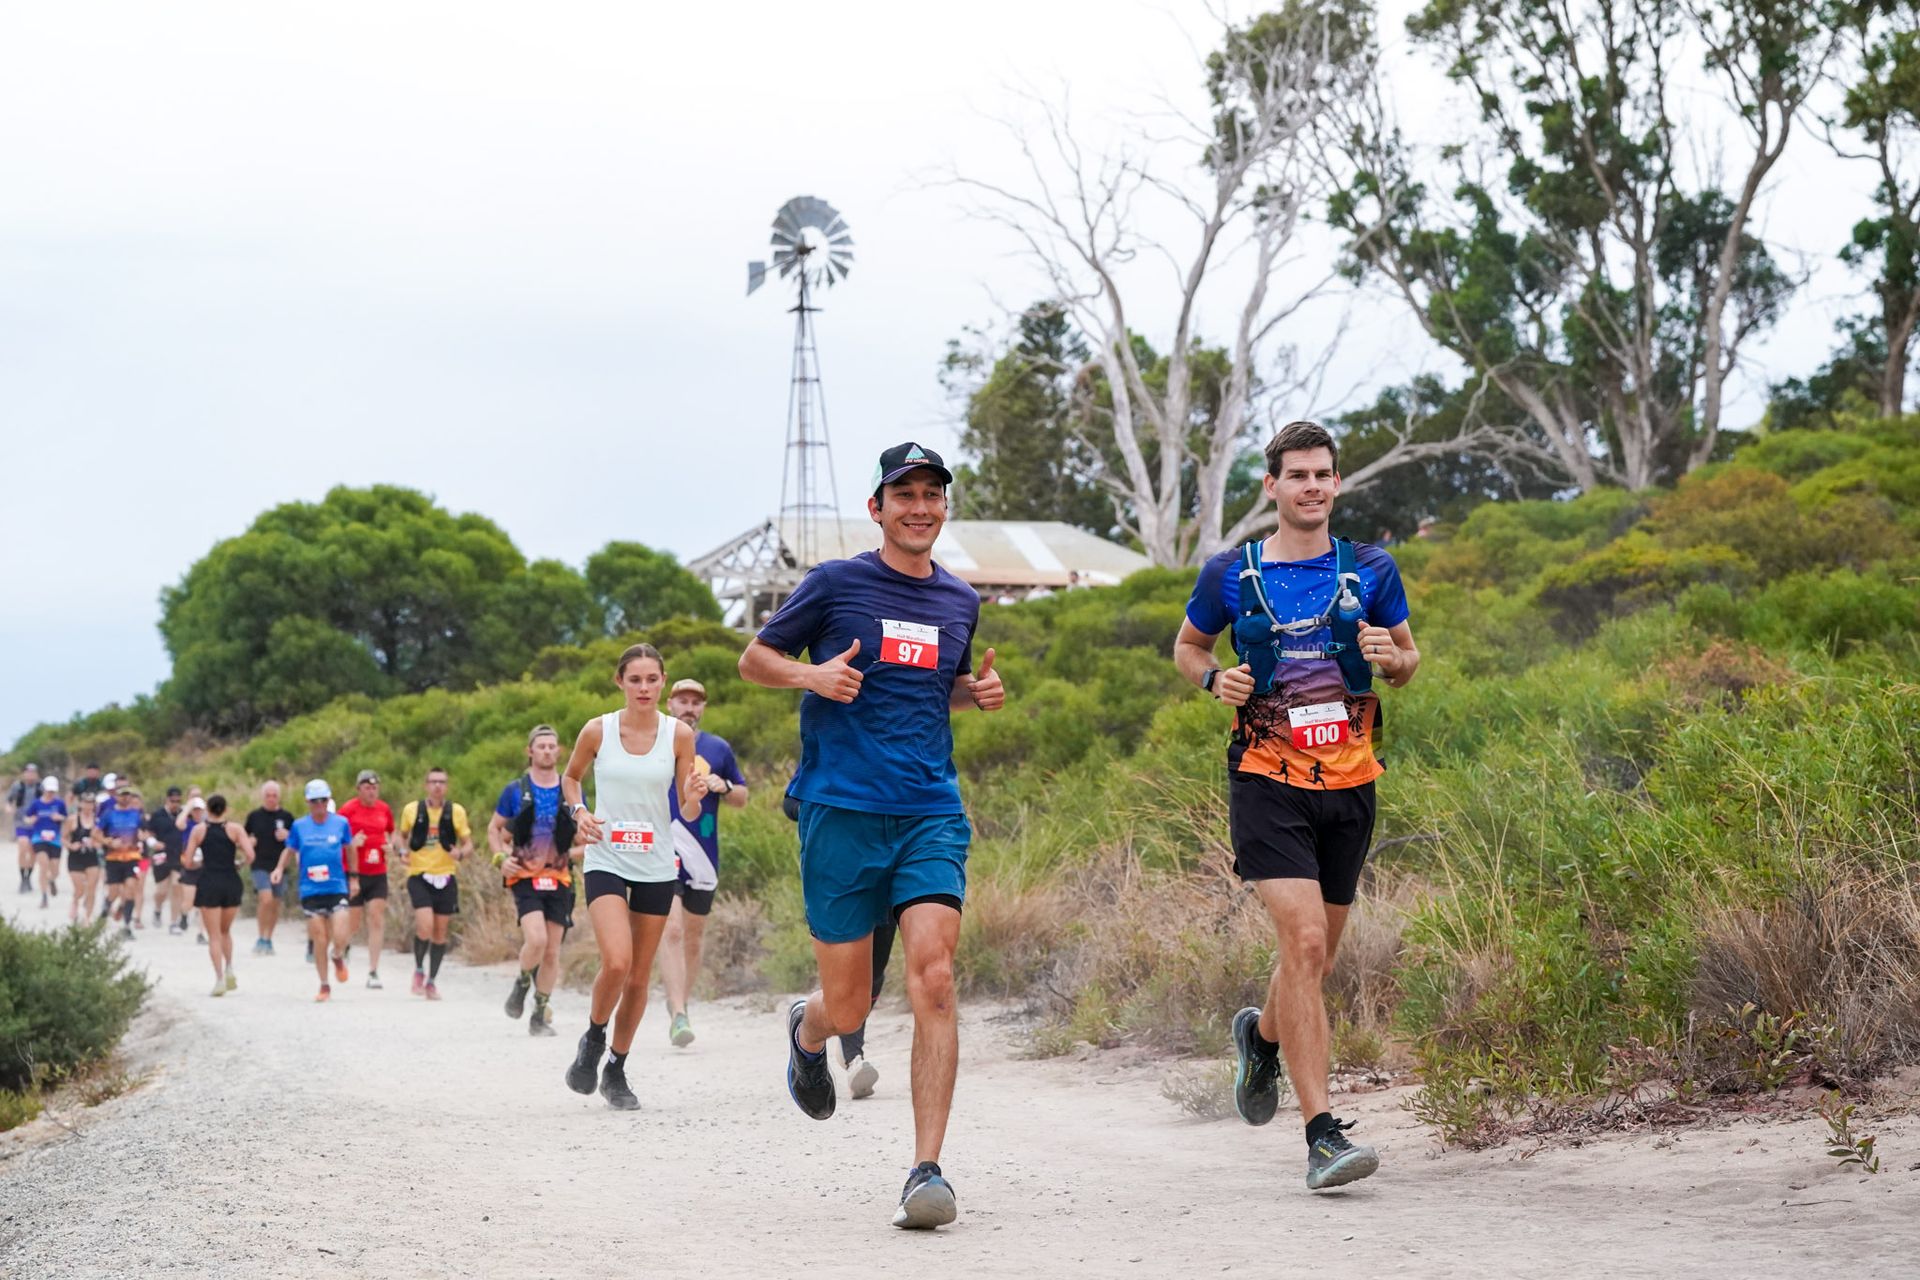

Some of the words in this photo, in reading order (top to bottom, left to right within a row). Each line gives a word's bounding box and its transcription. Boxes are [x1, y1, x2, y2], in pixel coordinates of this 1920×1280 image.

[898, 642, 923, 664] 97
[1303, 723, 1340, 747] 100
[622, 832, 643, 843] 433
